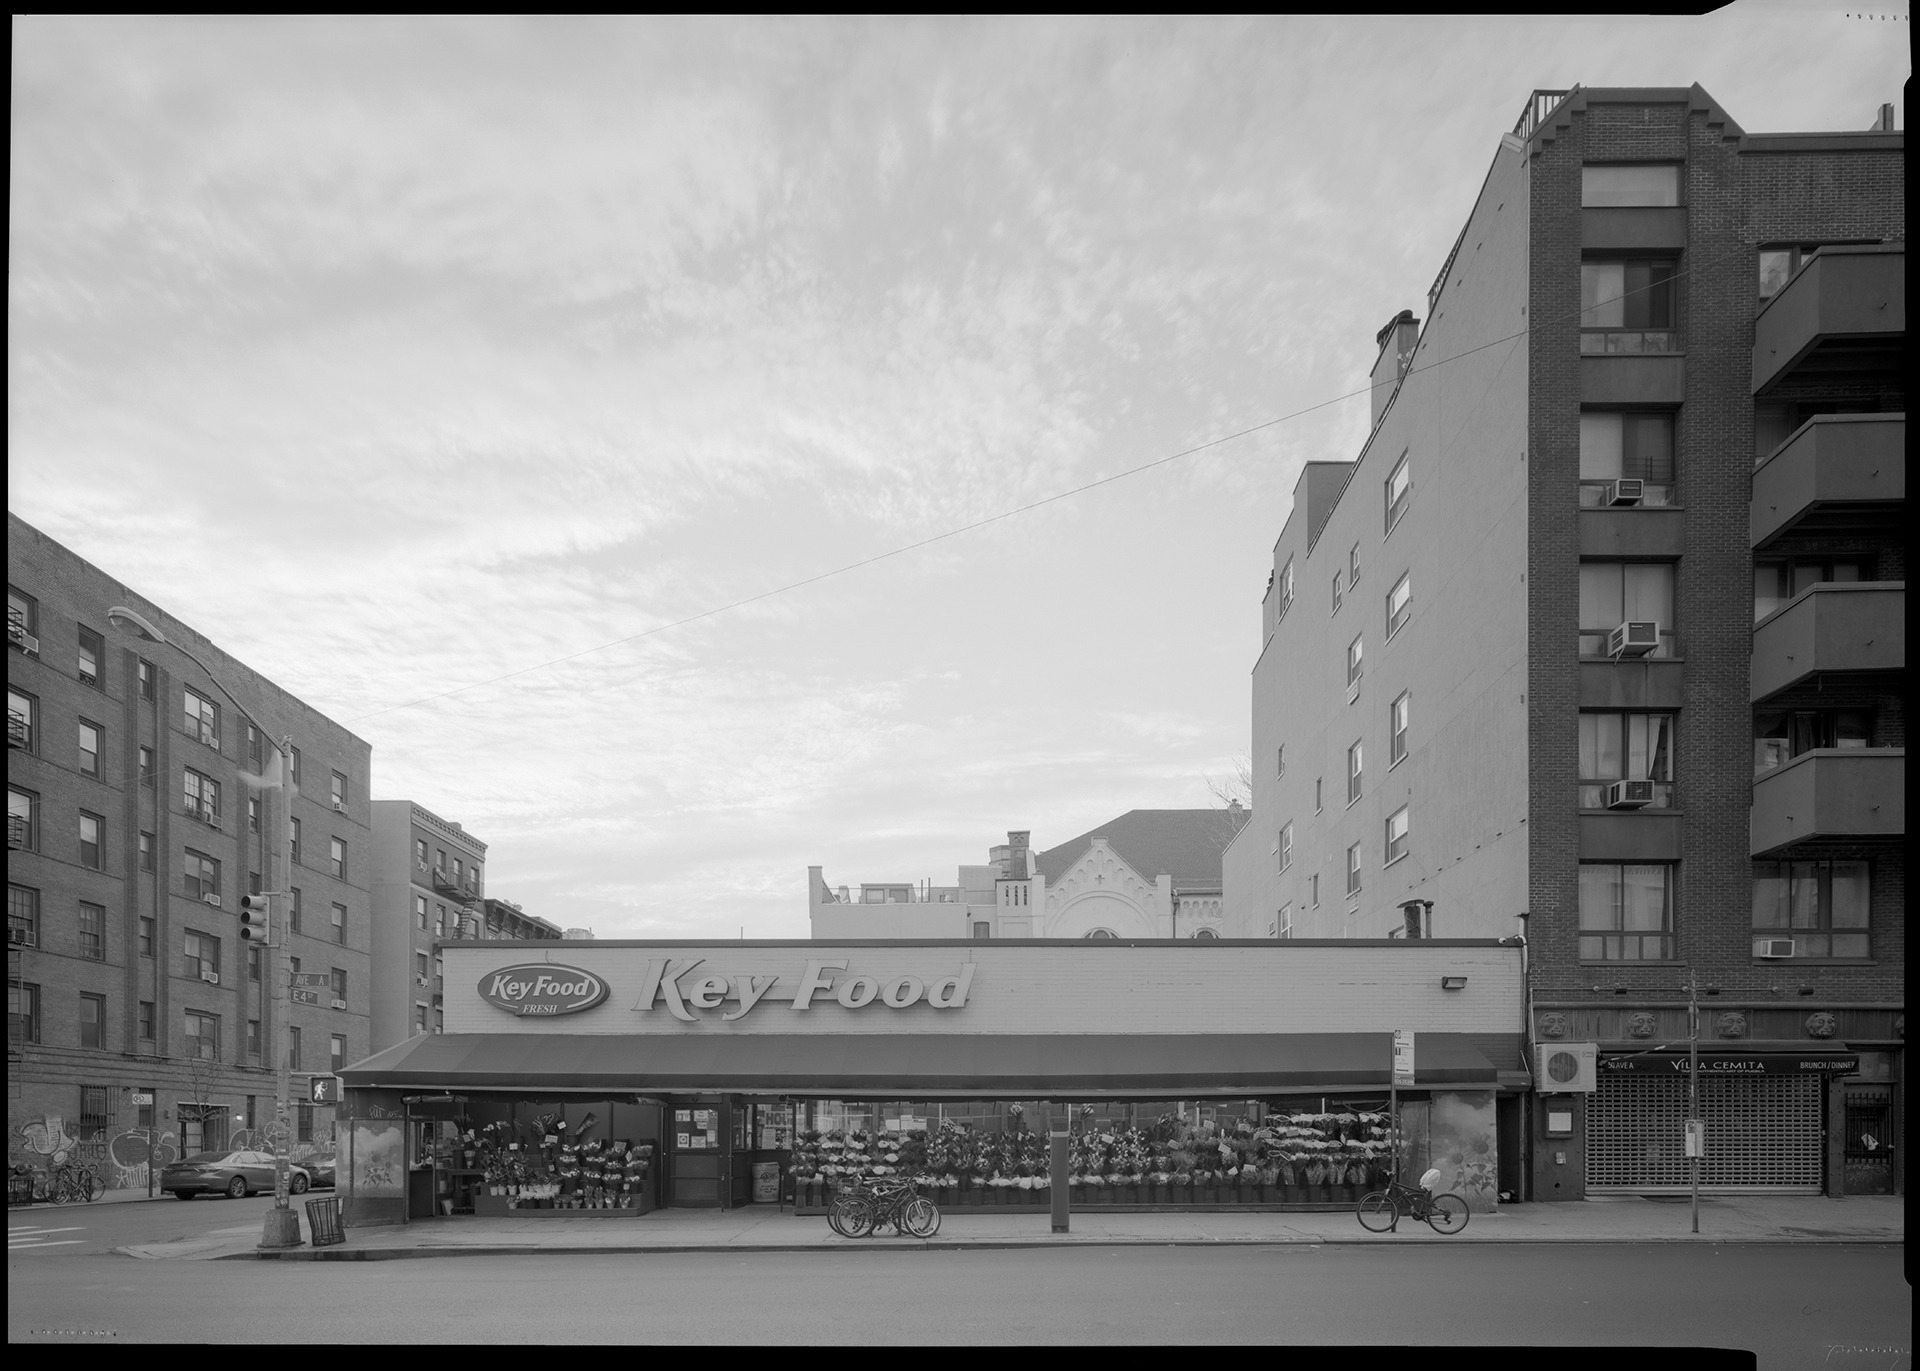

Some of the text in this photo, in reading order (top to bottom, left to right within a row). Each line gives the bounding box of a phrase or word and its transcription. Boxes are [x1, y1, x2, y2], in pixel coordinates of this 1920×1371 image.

[295, 974, 325, 986] AVE A
[488, 975, 590, 1001] Key Food
[630, 958, 978, 1021] Key Food
[293, 990, 300, 1001] E
[523, 1004, 558, 1014] FRESH
[1615, 1061, 1628, 1070] AVE
[1628, 1061, 1635, 1070] A
[1671, 1058, 1765, 1070] VILA CEMITA
